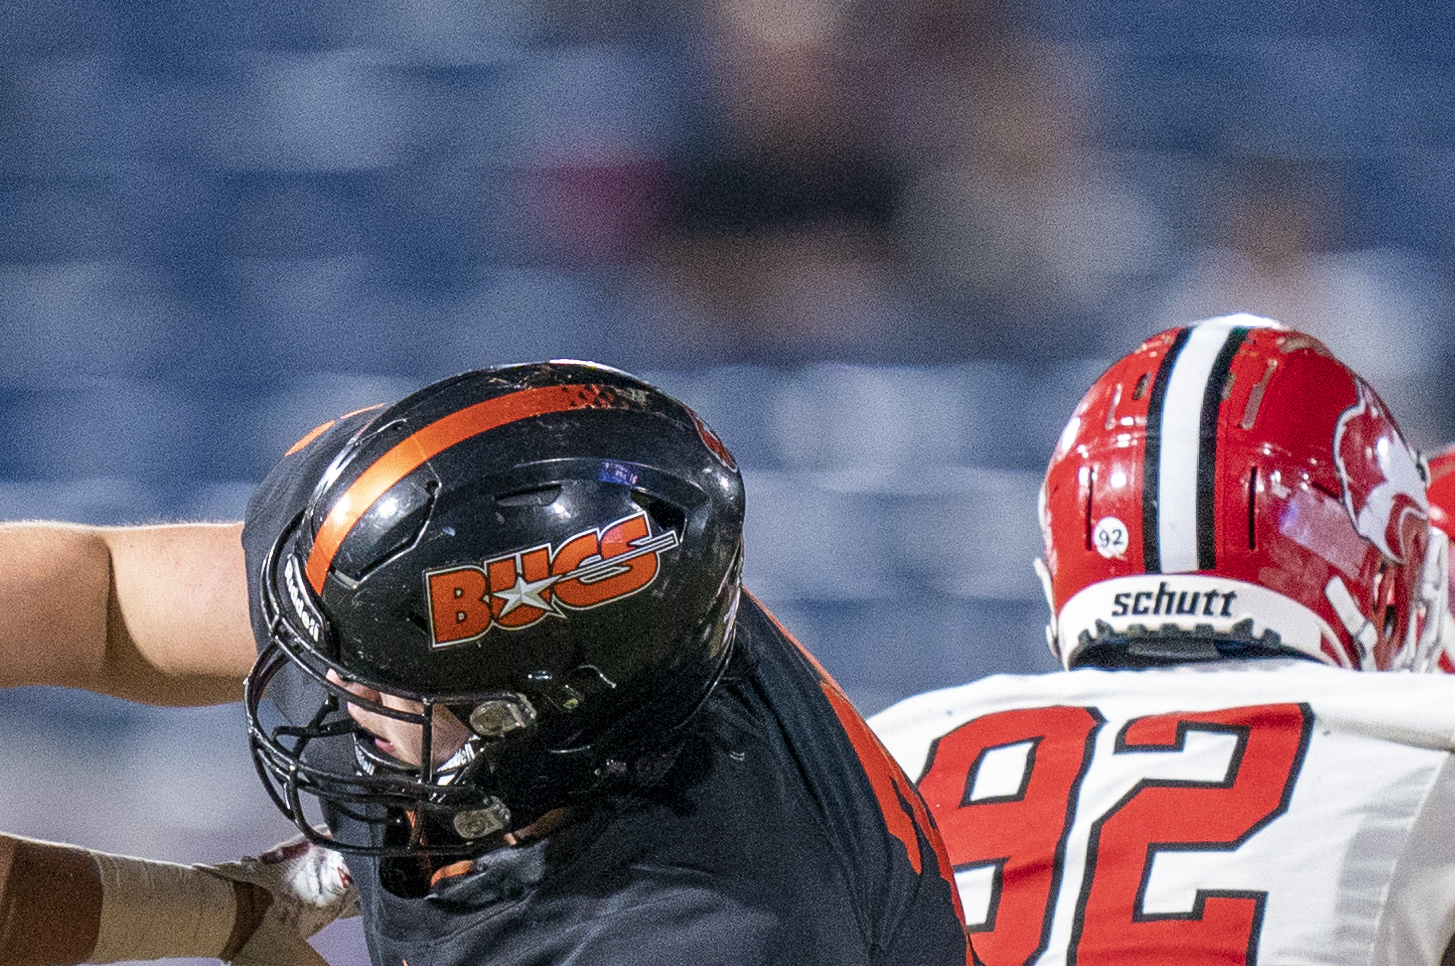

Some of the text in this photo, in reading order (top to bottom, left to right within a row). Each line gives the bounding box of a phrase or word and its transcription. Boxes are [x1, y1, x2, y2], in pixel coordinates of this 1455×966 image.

[1098, 528, 1124, 548] 92
[425, 511, 678, 649] BUCS
[1111, 581, 1238, 617] schutt
